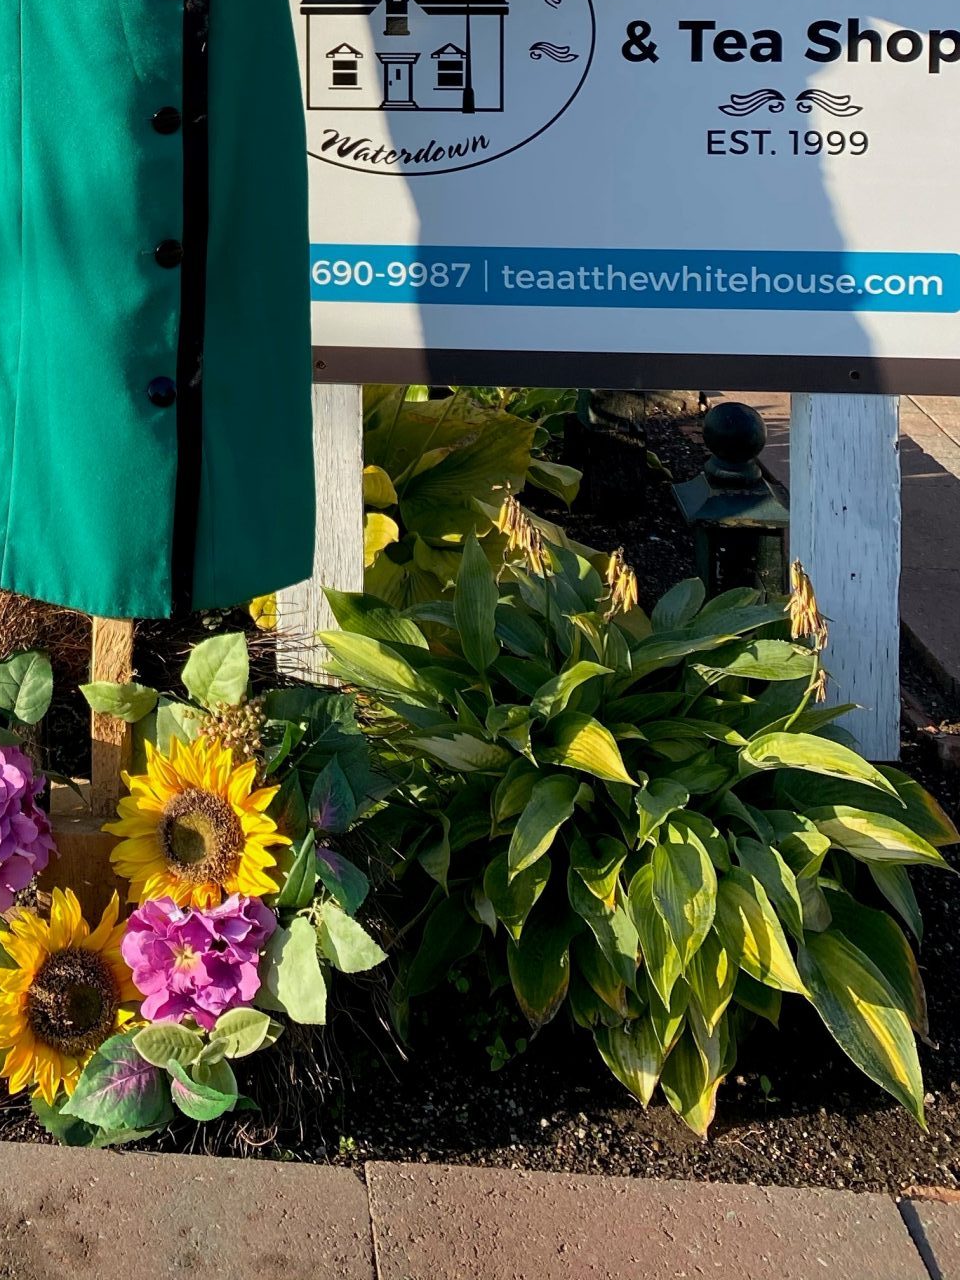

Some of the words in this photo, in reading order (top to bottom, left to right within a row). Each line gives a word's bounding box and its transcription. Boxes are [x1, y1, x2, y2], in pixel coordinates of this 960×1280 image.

[621, 20, 660, 64] &
[678, 20, 783, 63] Tea
[804, 18, 960, 74] Shop
[321, 128, 490, 165] Waterdown
[707, 130, 777, 155] EST.
[788, 130, 869, 156] 1999
[501, 263, 943, 297] teaatthewhitehouse.com
